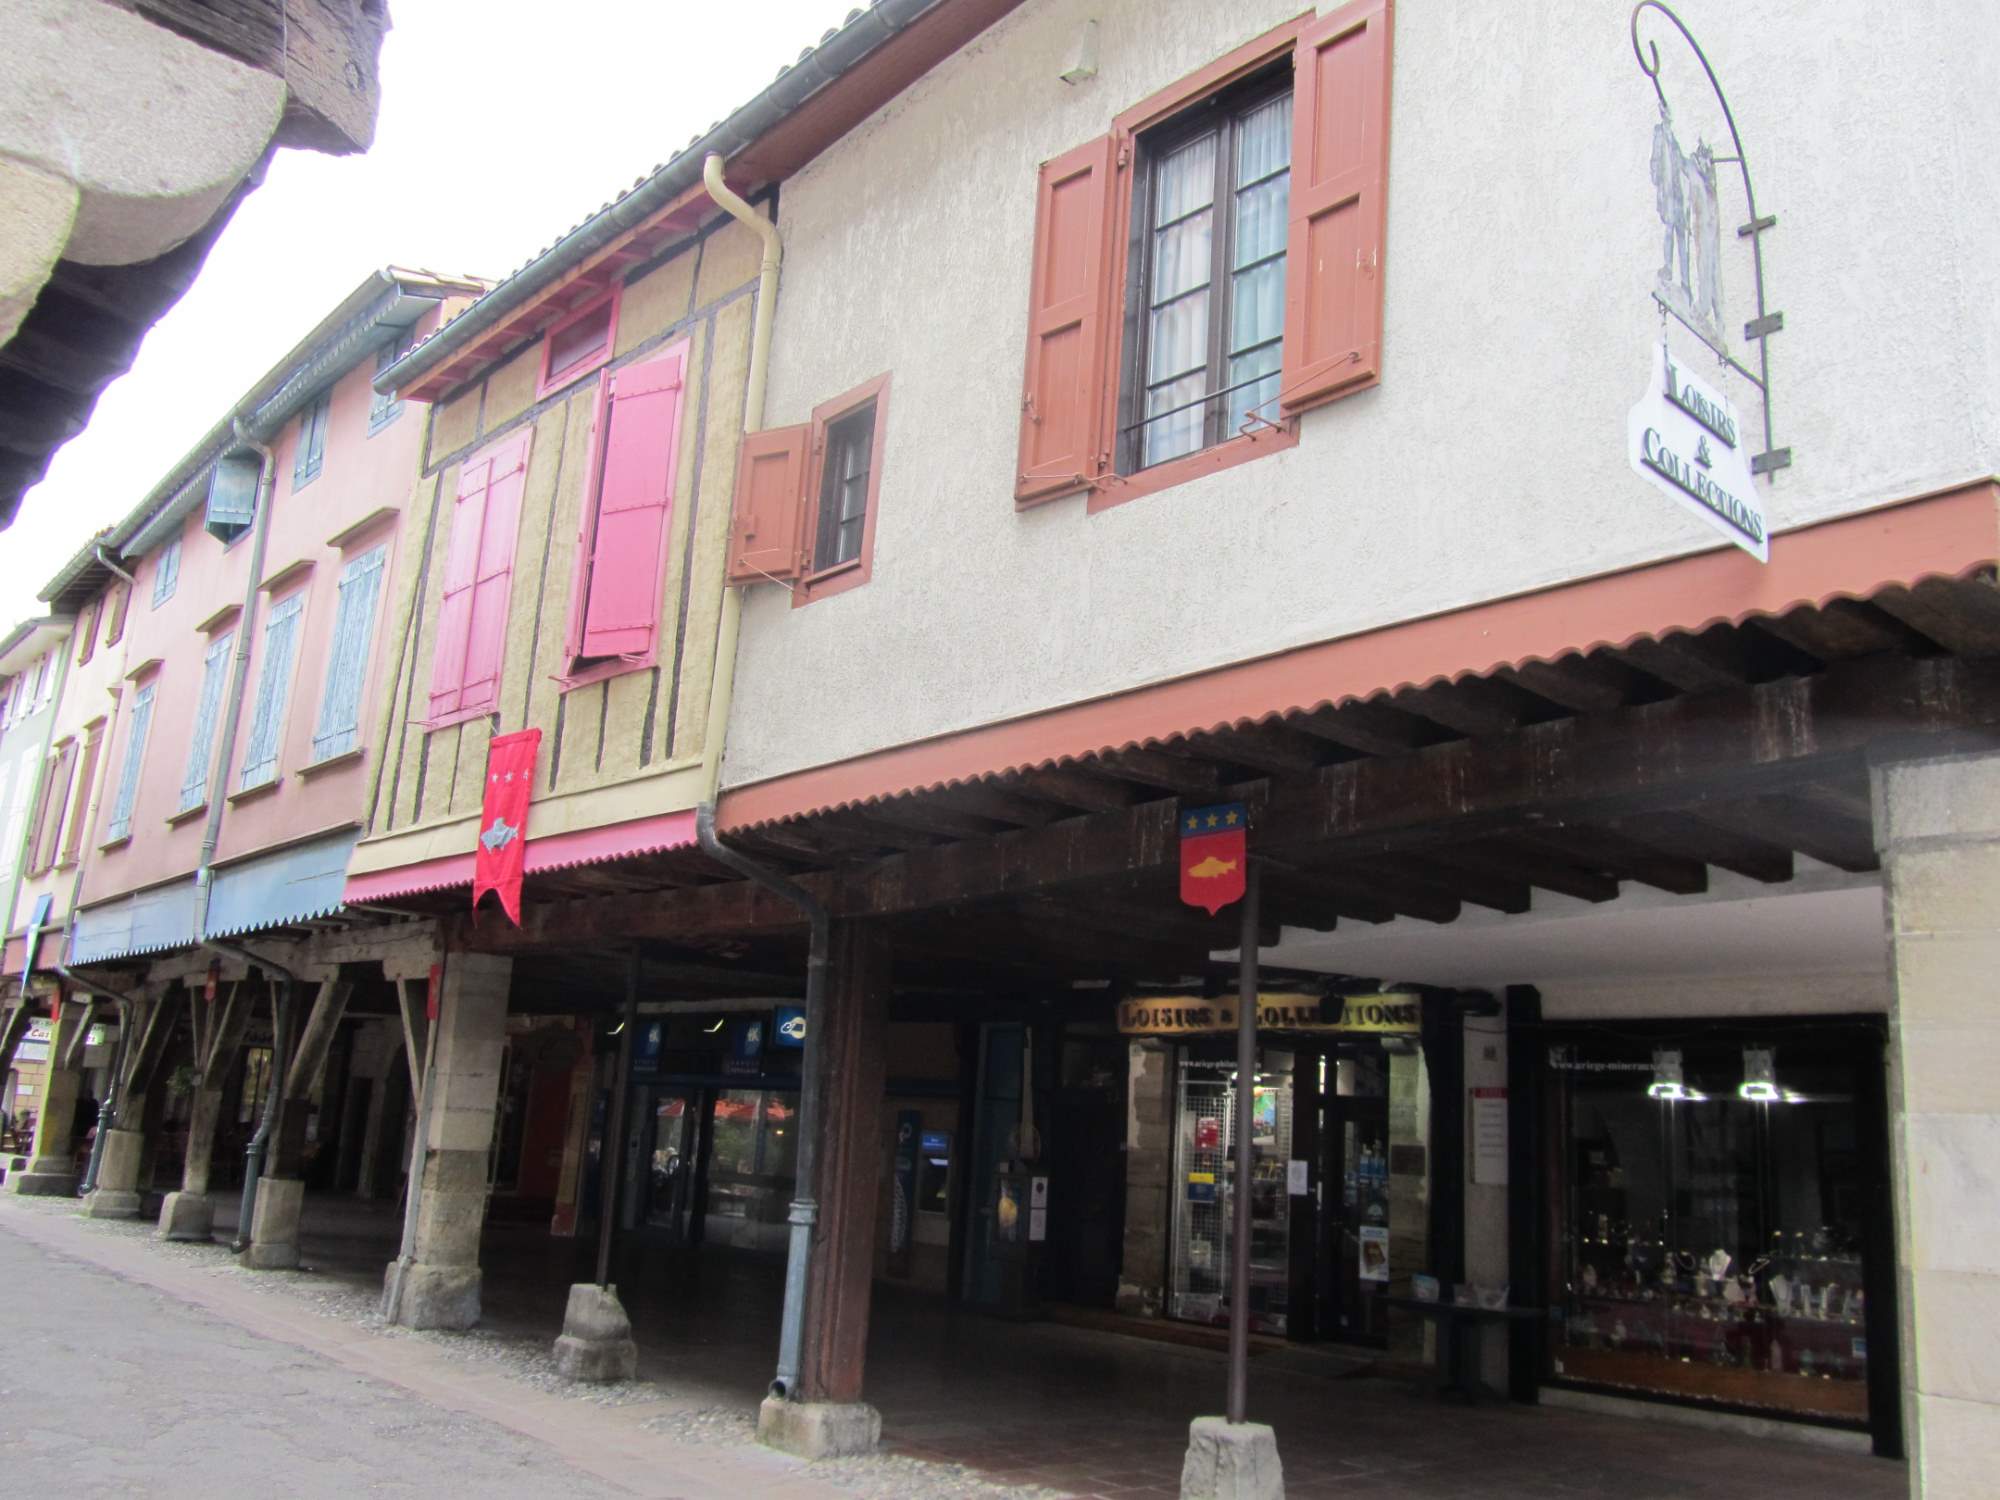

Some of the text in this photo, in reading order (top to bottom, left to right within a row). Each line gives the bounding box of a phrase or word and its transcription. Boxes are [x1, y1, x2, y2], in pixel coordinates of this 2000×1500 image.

[1664, 363, 1737, 448] LOISIRS
[1694, 434, 1712, 469] &
[1640, 427, 1763, 543] COLLECTIONS
[1120, 1003, 1214, 1027] LOISIRS
